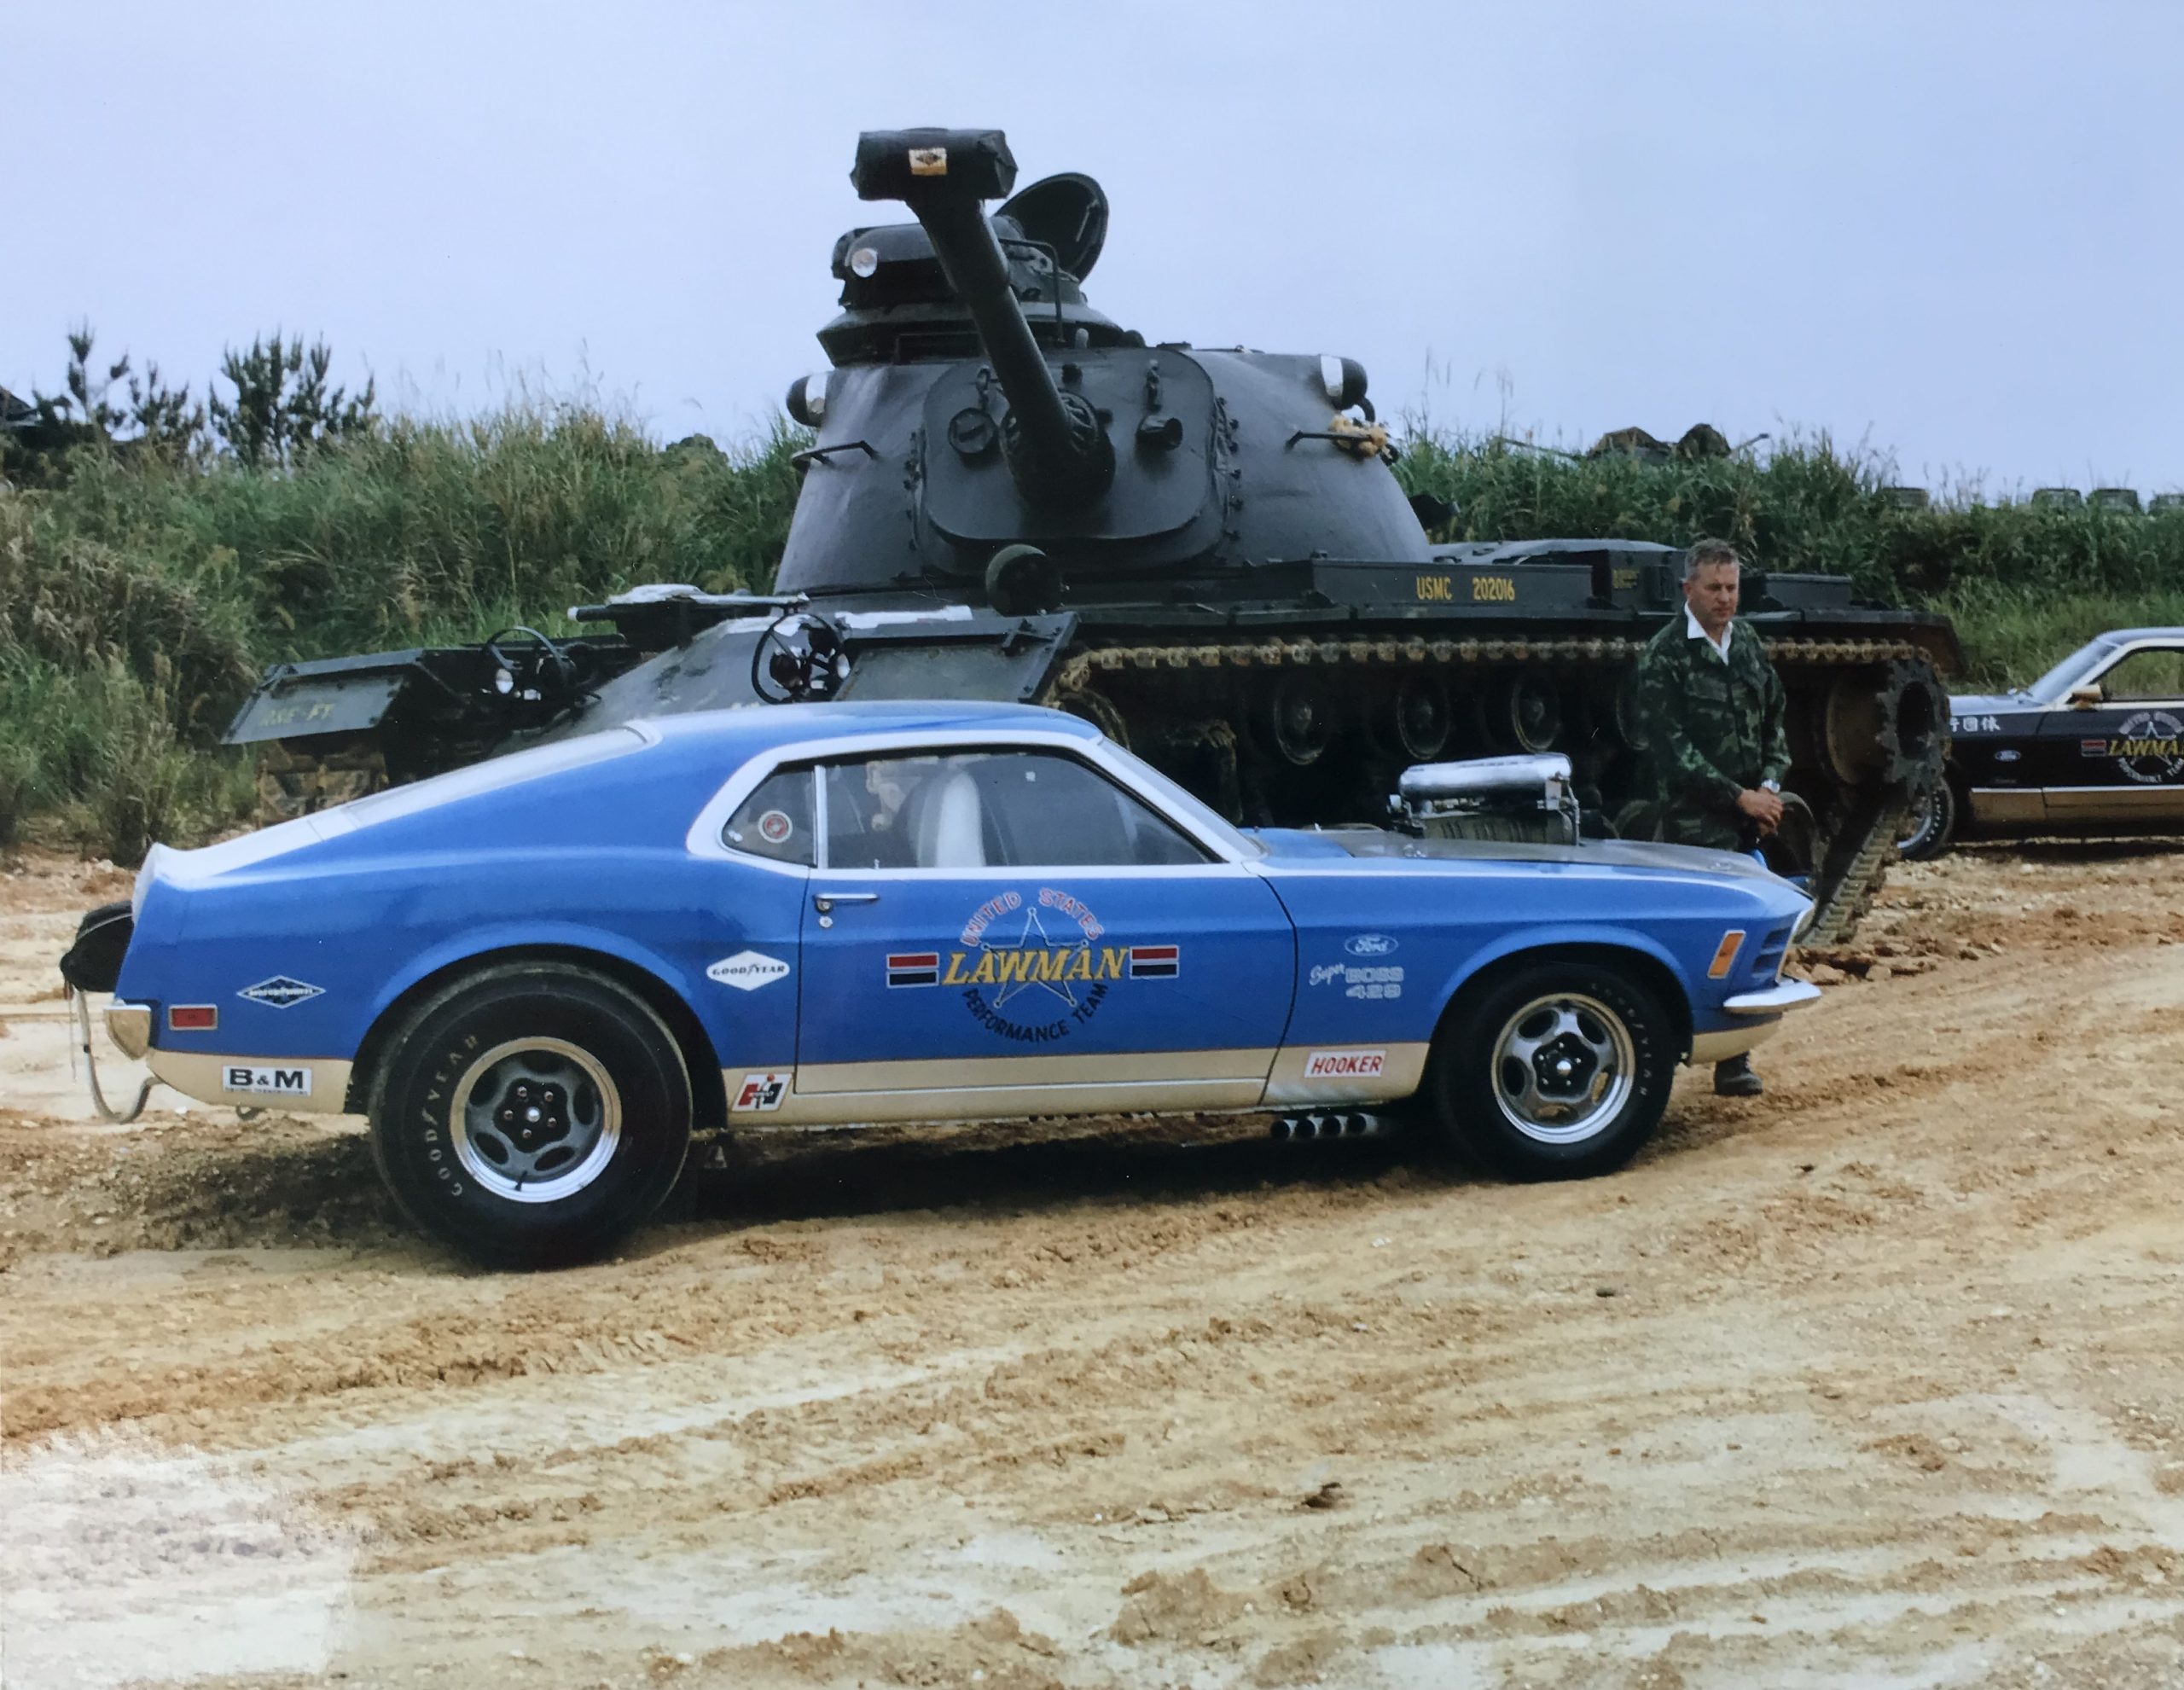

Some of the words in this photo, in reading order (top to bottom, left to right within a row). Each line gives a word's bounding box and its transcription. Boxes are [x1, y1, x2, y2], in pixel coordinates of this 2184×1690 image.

[1417, 576, 1452, 600] USMC
[2108, 740, 2184, 756] LAWMA
[960, 891, 1021, 947] UNITED
[1039, 887, 1105, 940] STATES
[1355, 937, 1389, 953] Ford
[712, 964, 786, 977] GOODYEAR
[941, 947, 1130, 986] LAWMAN
[1345, 967, 1404, 984] BOSS
[962, 987, 1070, 1042] PERFORMANCE
[1072, 982, 1108, 1024] TEAM
[1310, 1055, 1383, 1076] HOOKER
[422, 1034, 479, 1196] GOODYEAR
